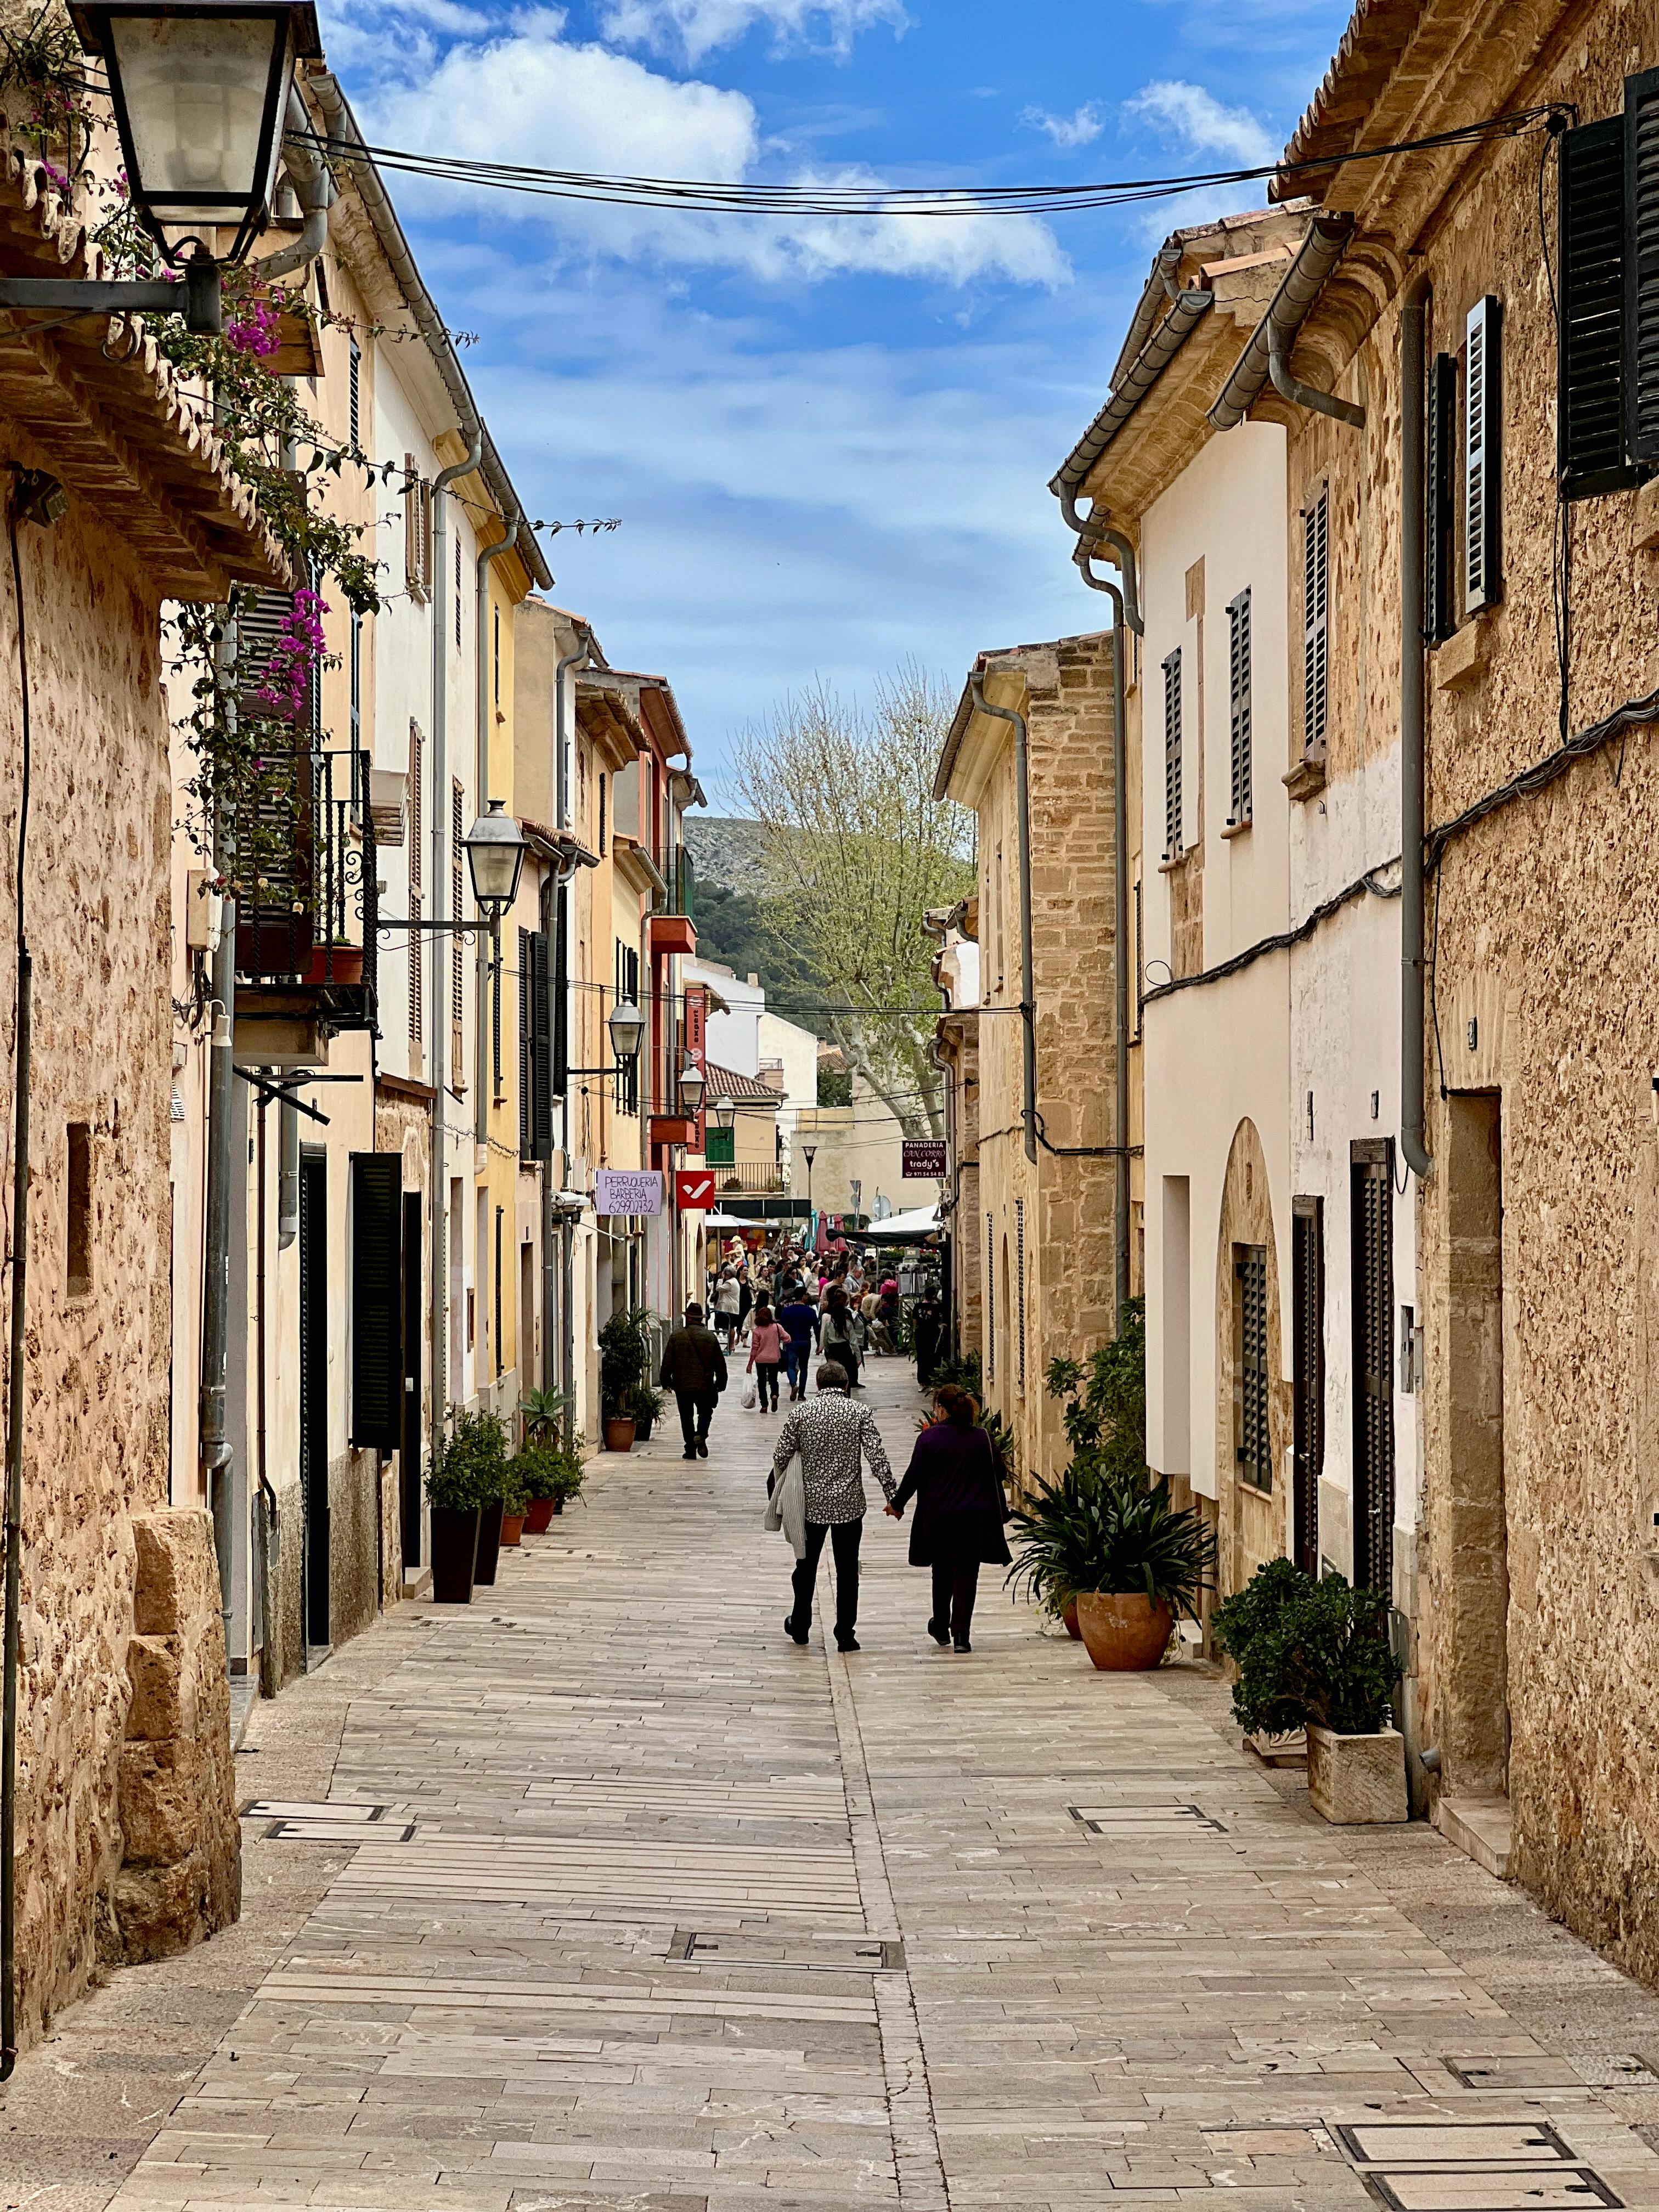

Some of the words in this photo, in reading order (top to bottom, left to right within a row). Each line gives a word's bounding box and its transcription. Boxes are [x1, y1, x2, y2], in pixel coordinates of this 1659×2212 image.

[903, 1149, 921, 1158] CAN
[910, 1159, 940, 1170] trady's
[605, 1176, 658, 1189] PERRUQUERIA
[610, 1188, 647, 1201] BARBERIA
[608, 1199, 655, 1214] 629902732
